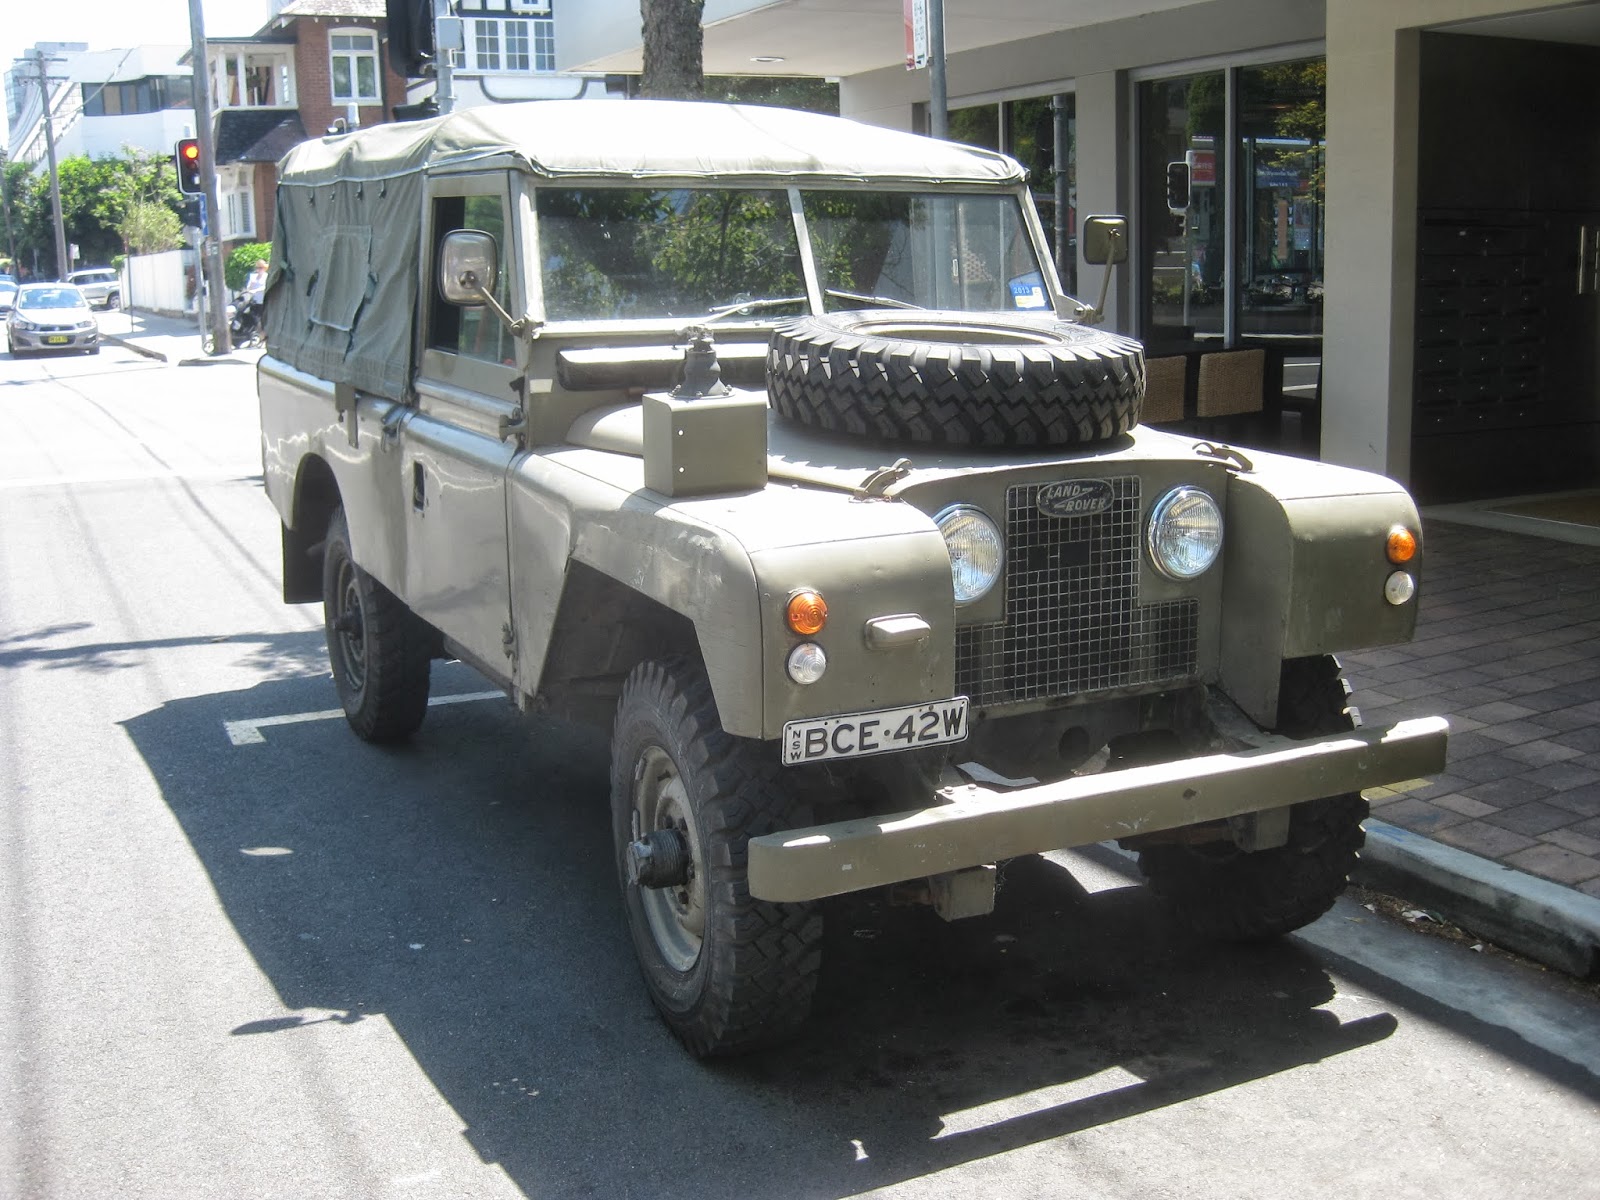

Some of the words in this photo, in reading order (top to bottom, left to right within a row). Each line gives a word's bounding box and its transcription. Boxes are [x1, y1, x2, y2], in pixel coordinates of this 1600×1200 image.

[1047, 485, 1081, 499] LAND
[1065, 498, 1106, 512] ROVER
[790, 729, 802, 761] NSW
